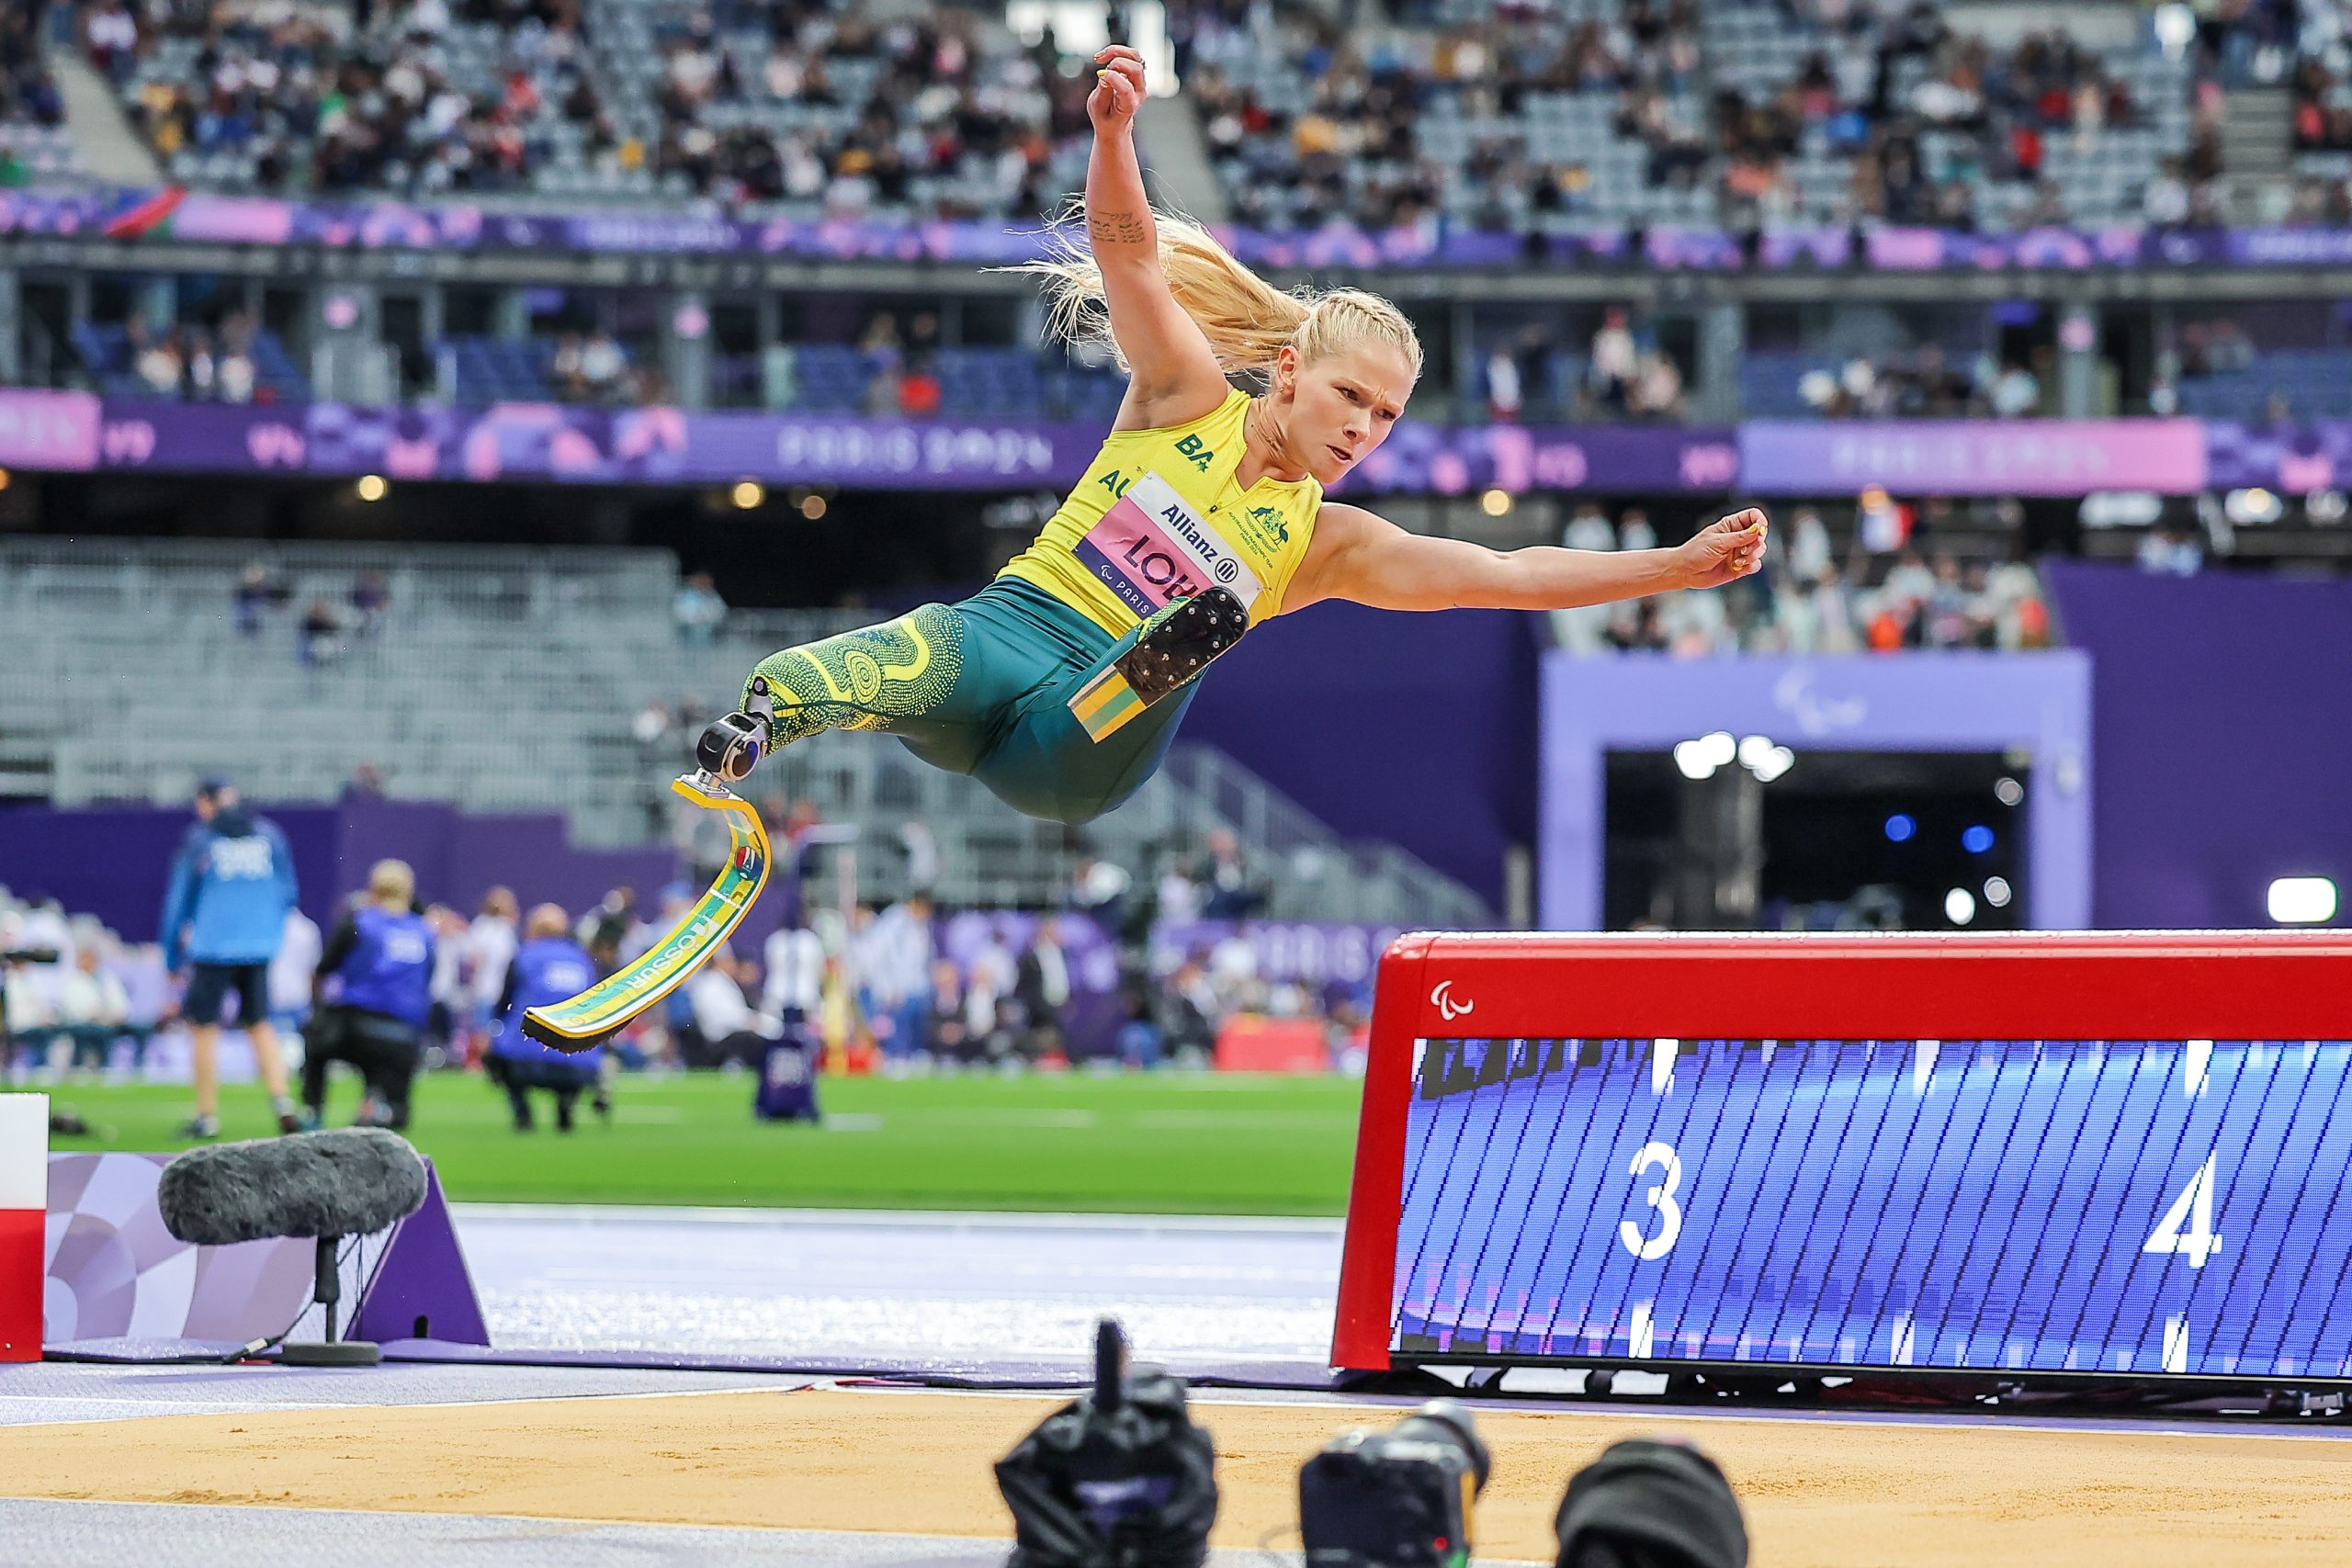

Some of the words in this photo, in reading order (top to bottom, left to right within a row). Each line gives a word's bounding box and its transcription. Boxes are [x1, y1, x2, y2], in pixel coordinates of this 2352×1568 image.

[1160, 503, 1218, 563] Allianz
[1228, 512, 1249, 537] AUSTRALIAN
[1116, 581, 1149, 614] PARIS
[626, 933, 701, 990] ÖSSUR
[1620, 1142, 1682, 1260] 3
[2142, 1149, 2223, 1267] 4
